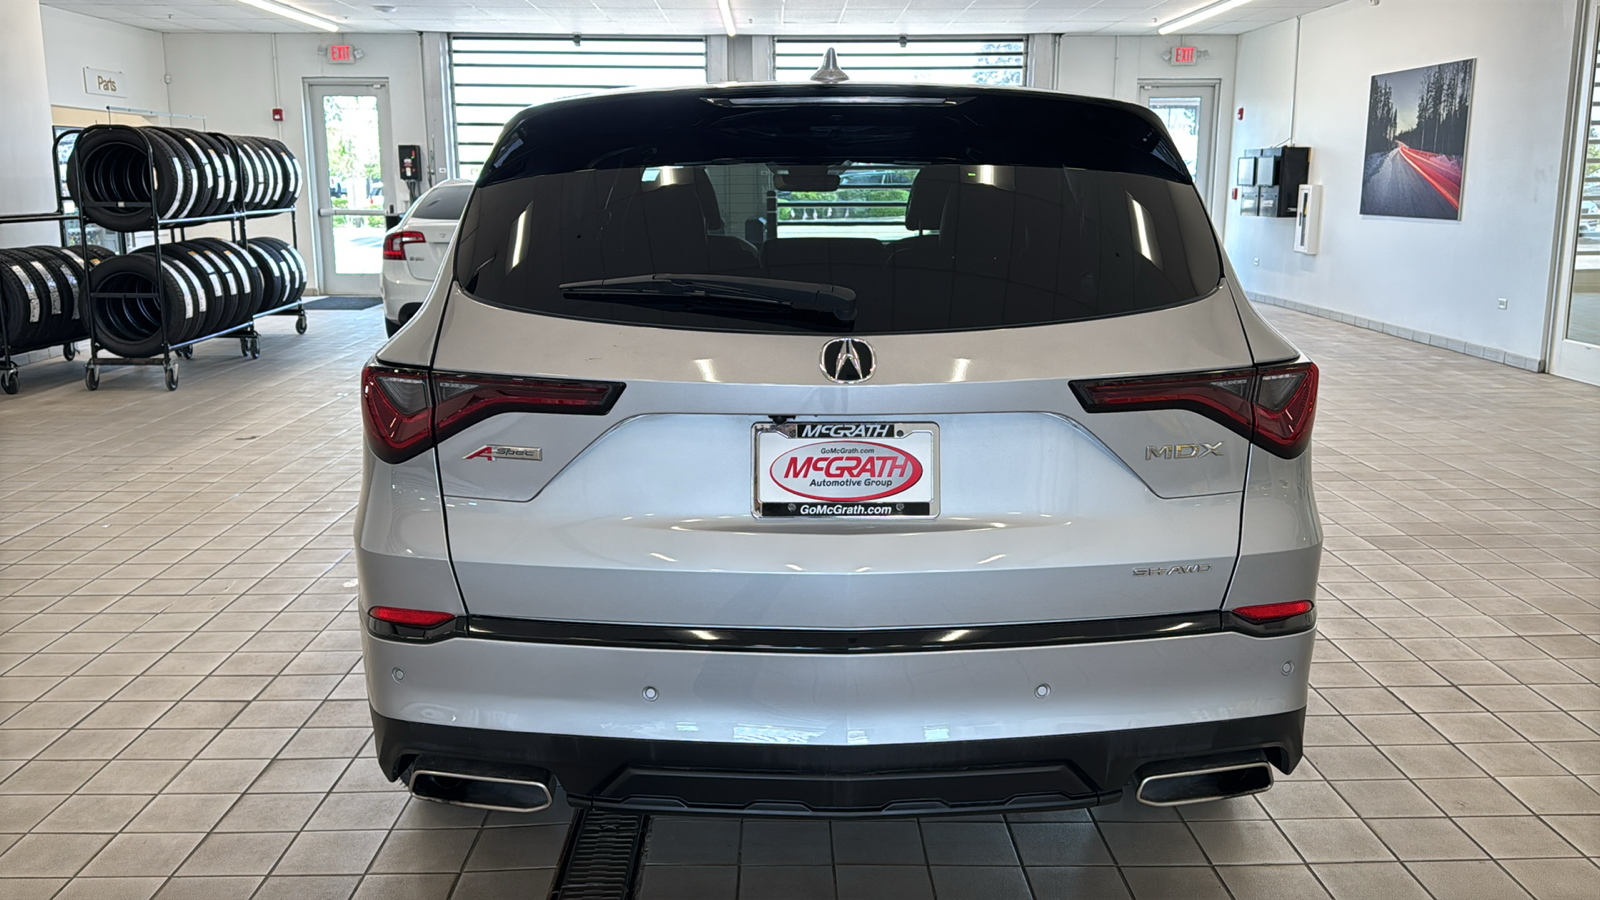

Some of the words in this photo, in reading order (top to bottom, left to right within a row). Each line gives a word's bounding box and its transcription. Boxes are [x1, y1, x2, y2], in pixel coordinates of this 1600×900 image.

[331, 45, 350, 60] EXIT
[1175, 47, 1195, 62] EXIT
[97, 75, 117, 92] Parts
[820, 447, 875, 455] GoMcGrath.com
[1145, 441, 1225, 461] MDX
[809, 478, 862, 487] Automotive
[864, 478, 893, 488] Group
[800, 504, 892, 515] GoMcGrath.com
